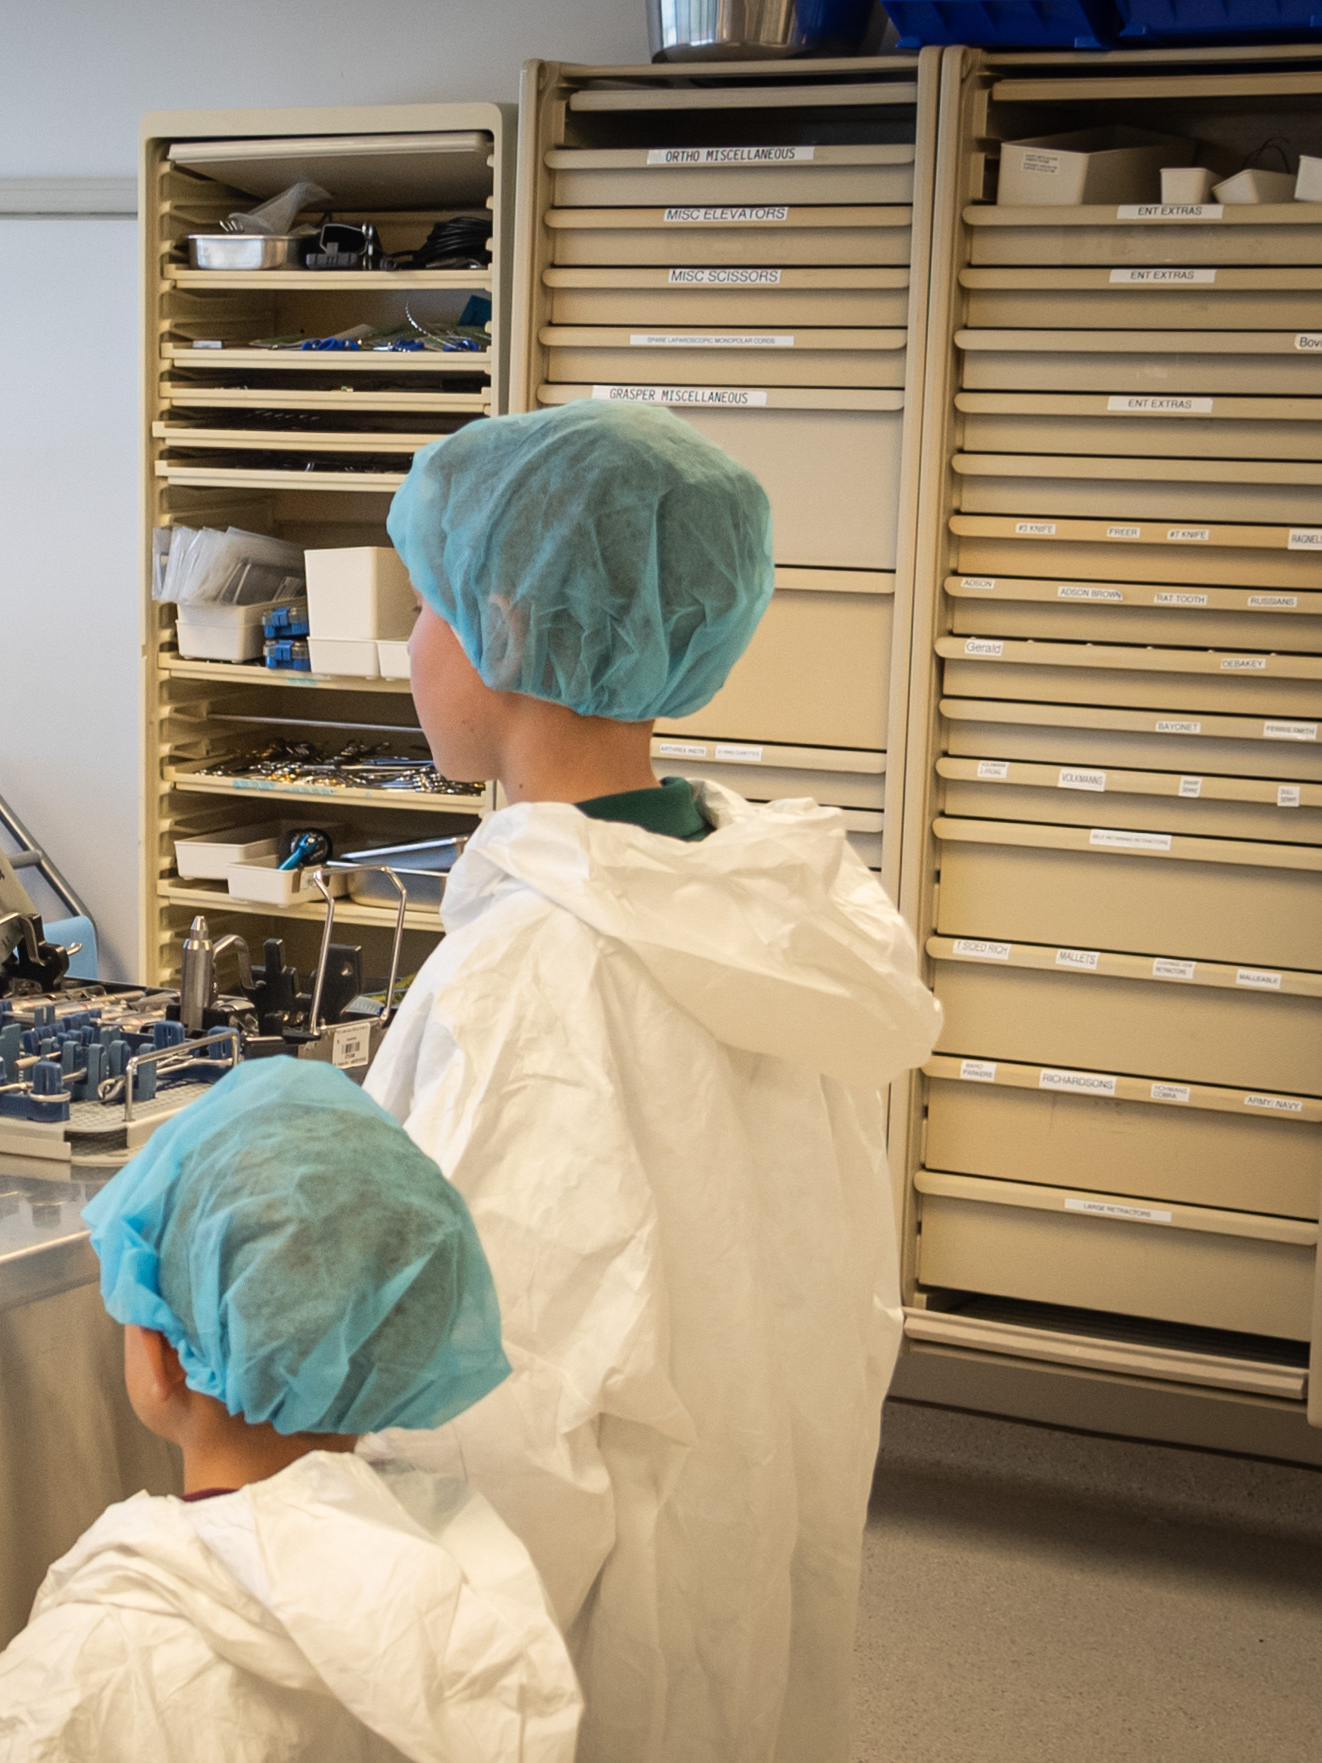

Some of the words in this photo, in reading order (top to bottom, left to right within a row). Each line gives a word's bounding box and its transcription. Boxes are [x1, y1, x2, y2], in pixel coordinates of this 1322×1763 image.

[666, 151, 700, 162] ORTHO
[706, 148, 795, 161] MISCELLANEOUS
[667, 209, 700, 220] MISC
[704, 208, 785, 219] ELEVATORS
[1138, 207, 1159, 216] ENT
[1161, 206, 1202, 215] EXTRAS
[671, 270, 704, 282] MISC
[708, 271, 778, 282] SCISSORS
[1130, 271, 1151, 280] ENT
[1153, 271, 1194, 279] EXTRAS
[610, 388, 655, 400] GRASPER
[661, 390, 748, 404] MISCELLANEOUS
[1128, 399, 1149, 408] ENT
[1151, 400, 1192, 408] EXTRAS
[1029, 525, 1053, 533] KNIFE
[1109, 528, 1138, 536] FREER
[1182, 530, 1206, 539] KNIFE
[1291, 535, 1322, 544] RAGNEL
[964, 579, 992, 587] ADSON
[1060, 588, 1089, 597] ADSON
[1176, 595, 1204, 603] TOOTH
[1250, 597, 1294, 606] RUSSIANS
[966, 641, 1001, 654] Gerald
[1223, 660, 1263, 668] DEBAKEY
[1158, 723, 1198, 731] BAYONET
[963, 942, 986, 952] SIDED
[989, 944, 1007, 955] RICH
[1060, 951, 1095, 964] MALLETS
[1239, 974, 1278, 984] MALLEABLE
[963, 1069, 992, 1078] PARKERS
[1043, 1073, 1113, 1089] RICHARDSONS
[1276, 1100, 1300, 1109] NAVY
[1084, 1203, 1105, 1211] LARGE
[1107, 1206, 1151, 1217] RETRACTORS
